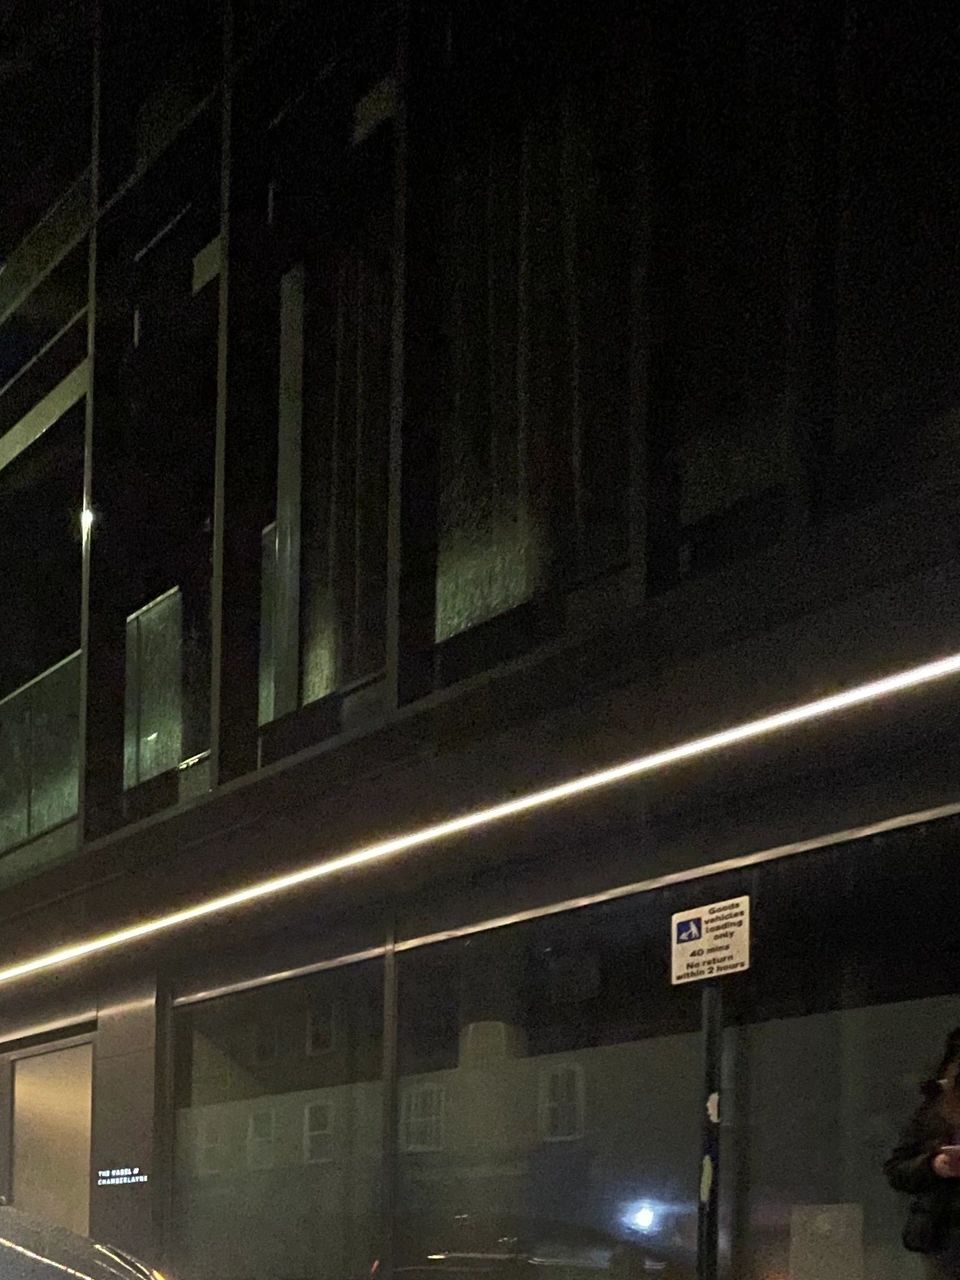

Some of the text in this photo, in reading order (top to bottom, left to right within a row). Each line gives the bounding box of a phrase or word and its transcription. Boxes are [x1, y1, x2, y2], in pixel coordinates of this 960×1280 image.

[708, 902, 740, 915] Goods
[704, 911, 744, 925] vehicles
[706, 919, 743, 933] loading
[713, 931, 734, 940] only
[689, 945, 730, 957] 40 mins
[686, 955, 734, 970] No return
[676, 970, 705, 980] within
[717, 962, 745, 972] hours
[97, 1175, 148, 1186] CHAMBERLAYNE
